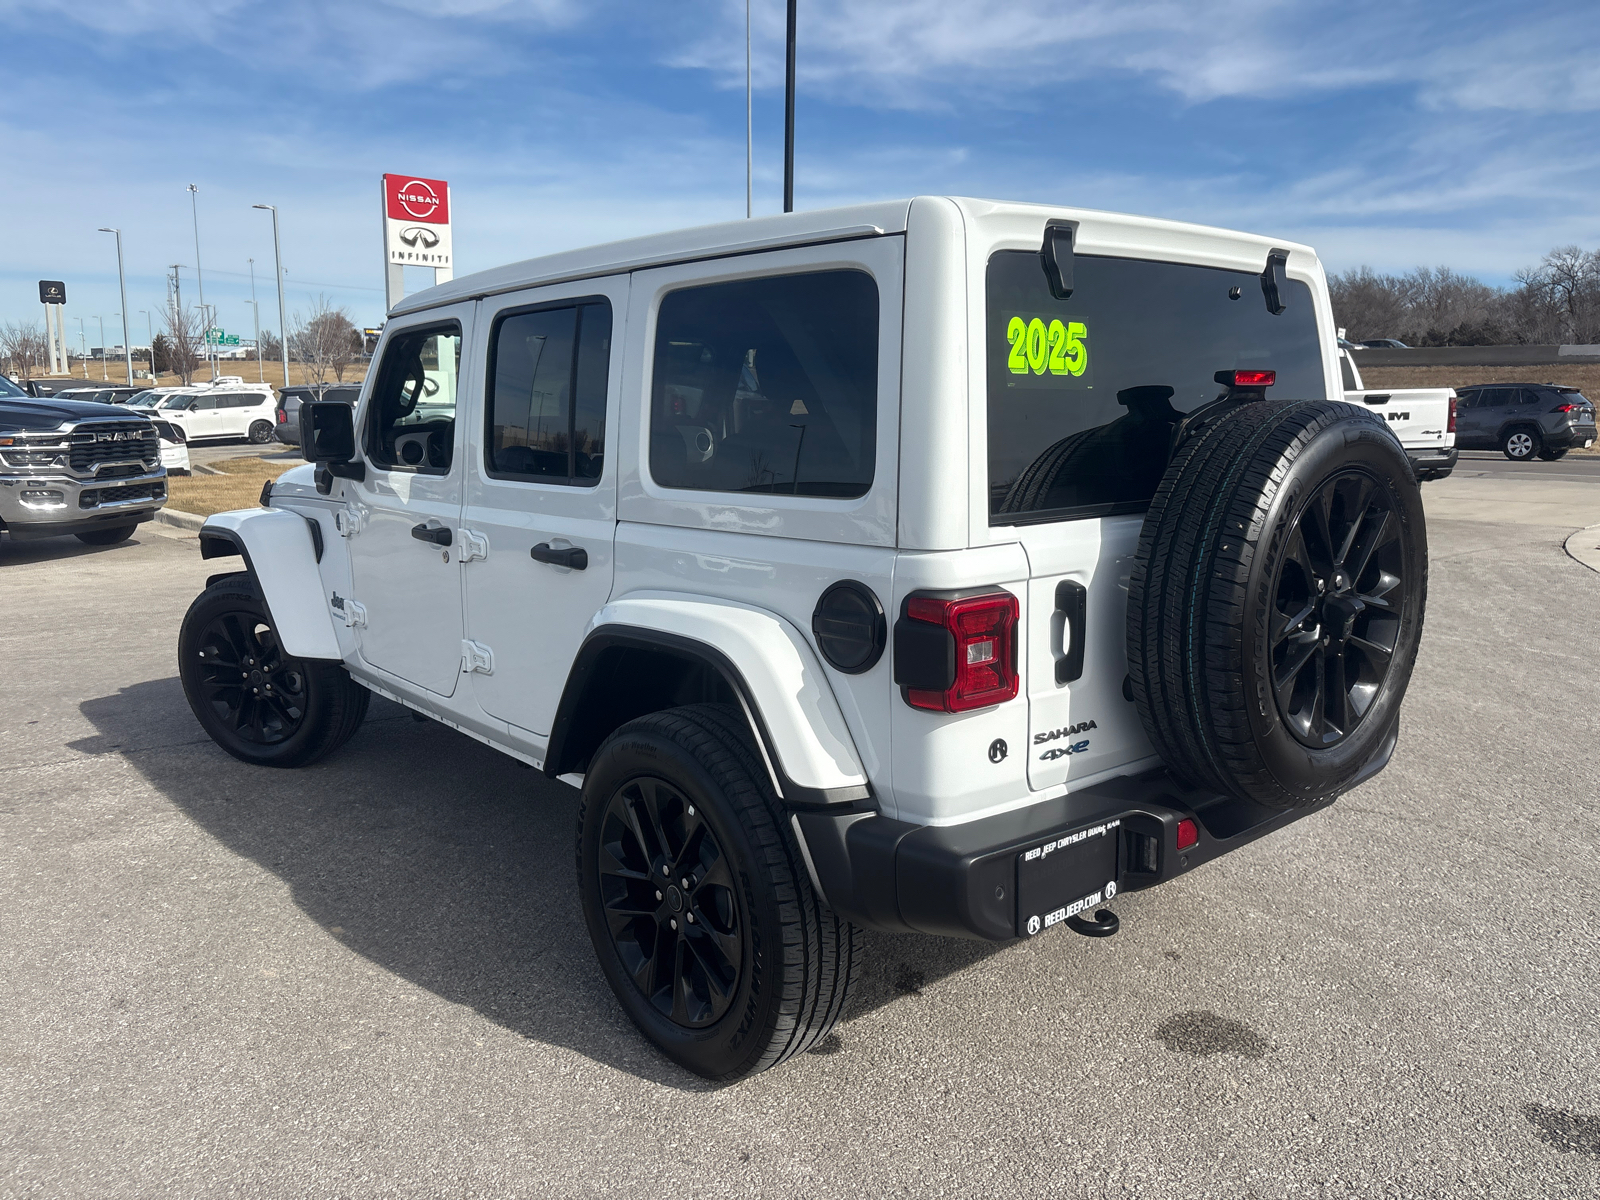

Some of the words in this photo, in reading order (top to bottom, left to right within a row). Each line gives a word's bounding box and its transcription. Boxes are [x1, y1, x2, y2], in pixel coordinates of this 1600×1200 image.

[398, 193, 439, 205] NISSAN
[392, 251, 449, 264] INFINITI
[1007, 316, 1088, 377] 2025
[97, 431, 143, 442] RAM
[1033, 720, 1098, 745] SAHARA
[1039, 740, 1090, 761] 4xe
[1025, 847, 1041, 862] REED
[1042, 841, 1057, 857] JEEP
[1057, 830, 1087, 849] CHRYSLER
[1044, 891, 1102, 928] REEDJEEP.COM
